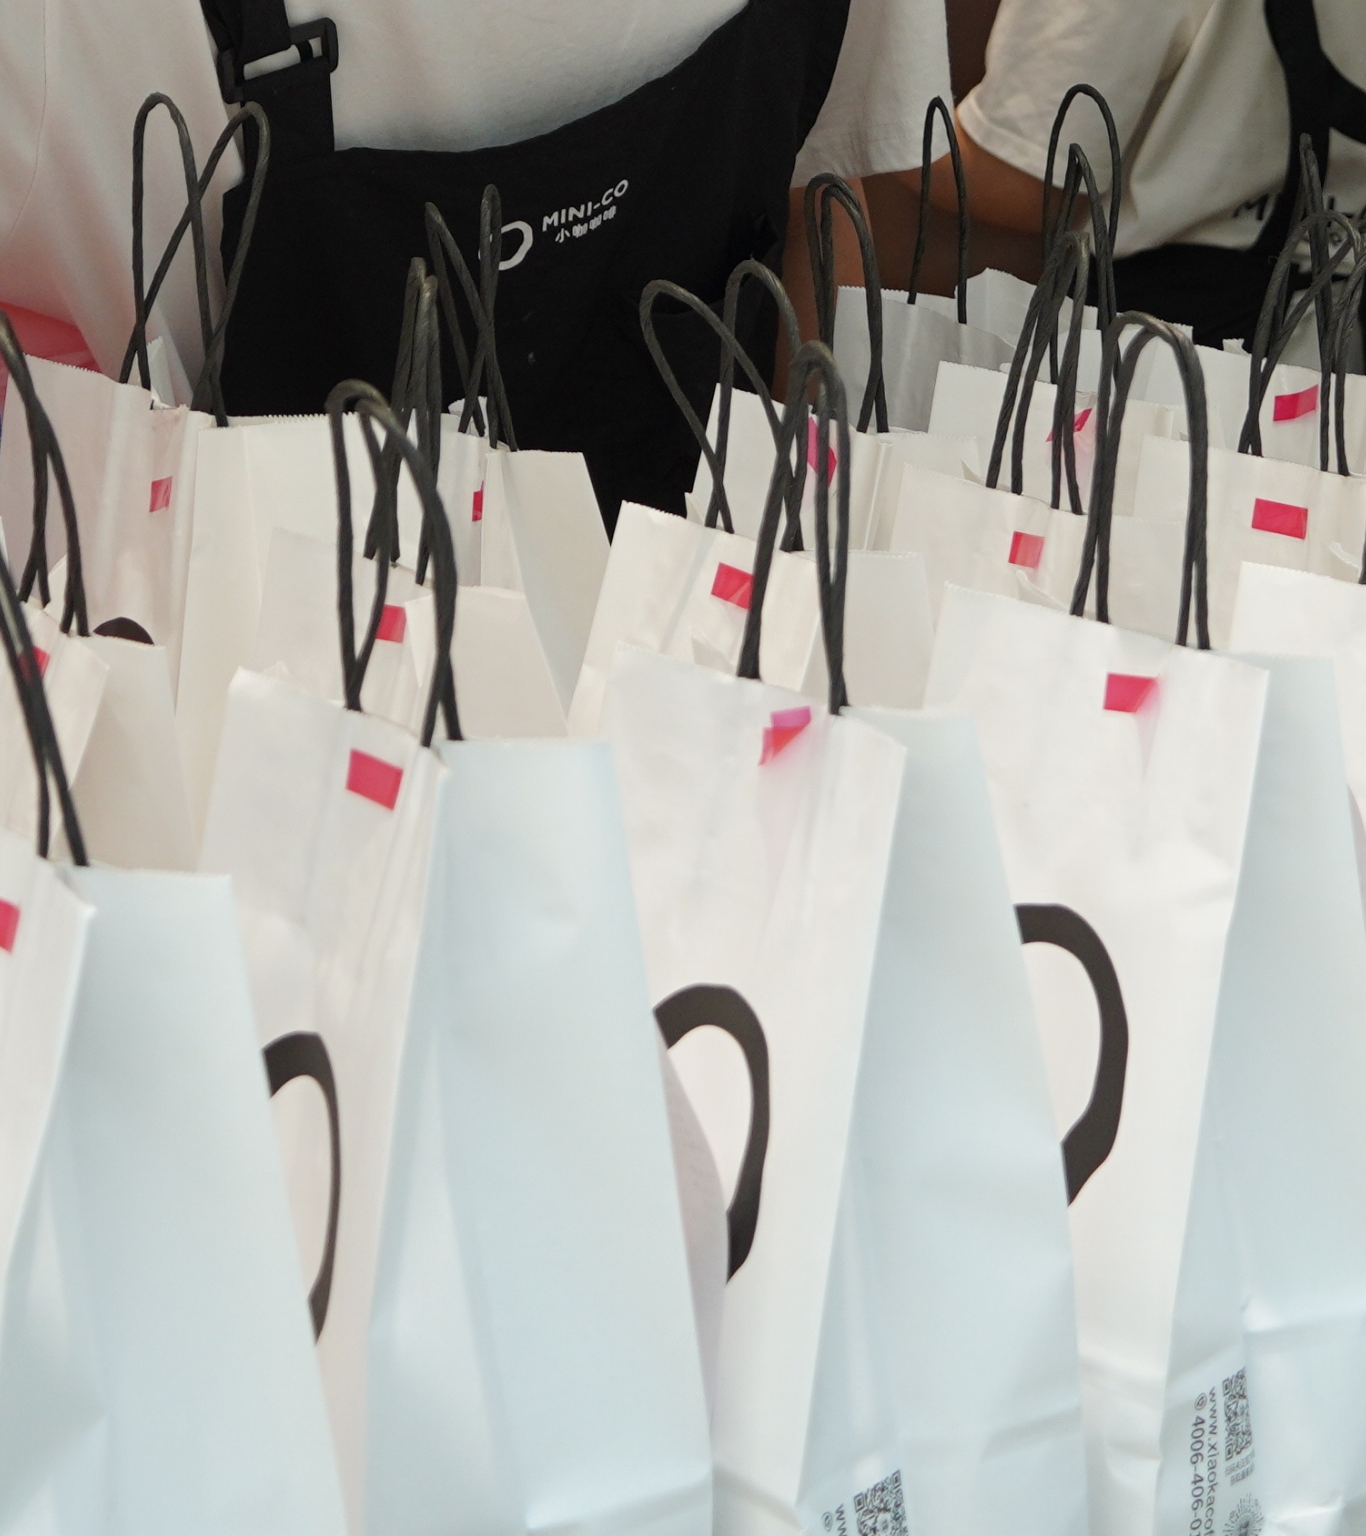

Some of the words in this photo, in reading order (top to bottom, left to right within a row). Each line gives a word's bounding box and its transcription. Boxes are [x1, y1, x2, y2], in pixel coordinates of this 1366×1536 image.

[542, 178, 629, 232] MINI-CO
[554, 205, 618, 243] 小咖咖啡
